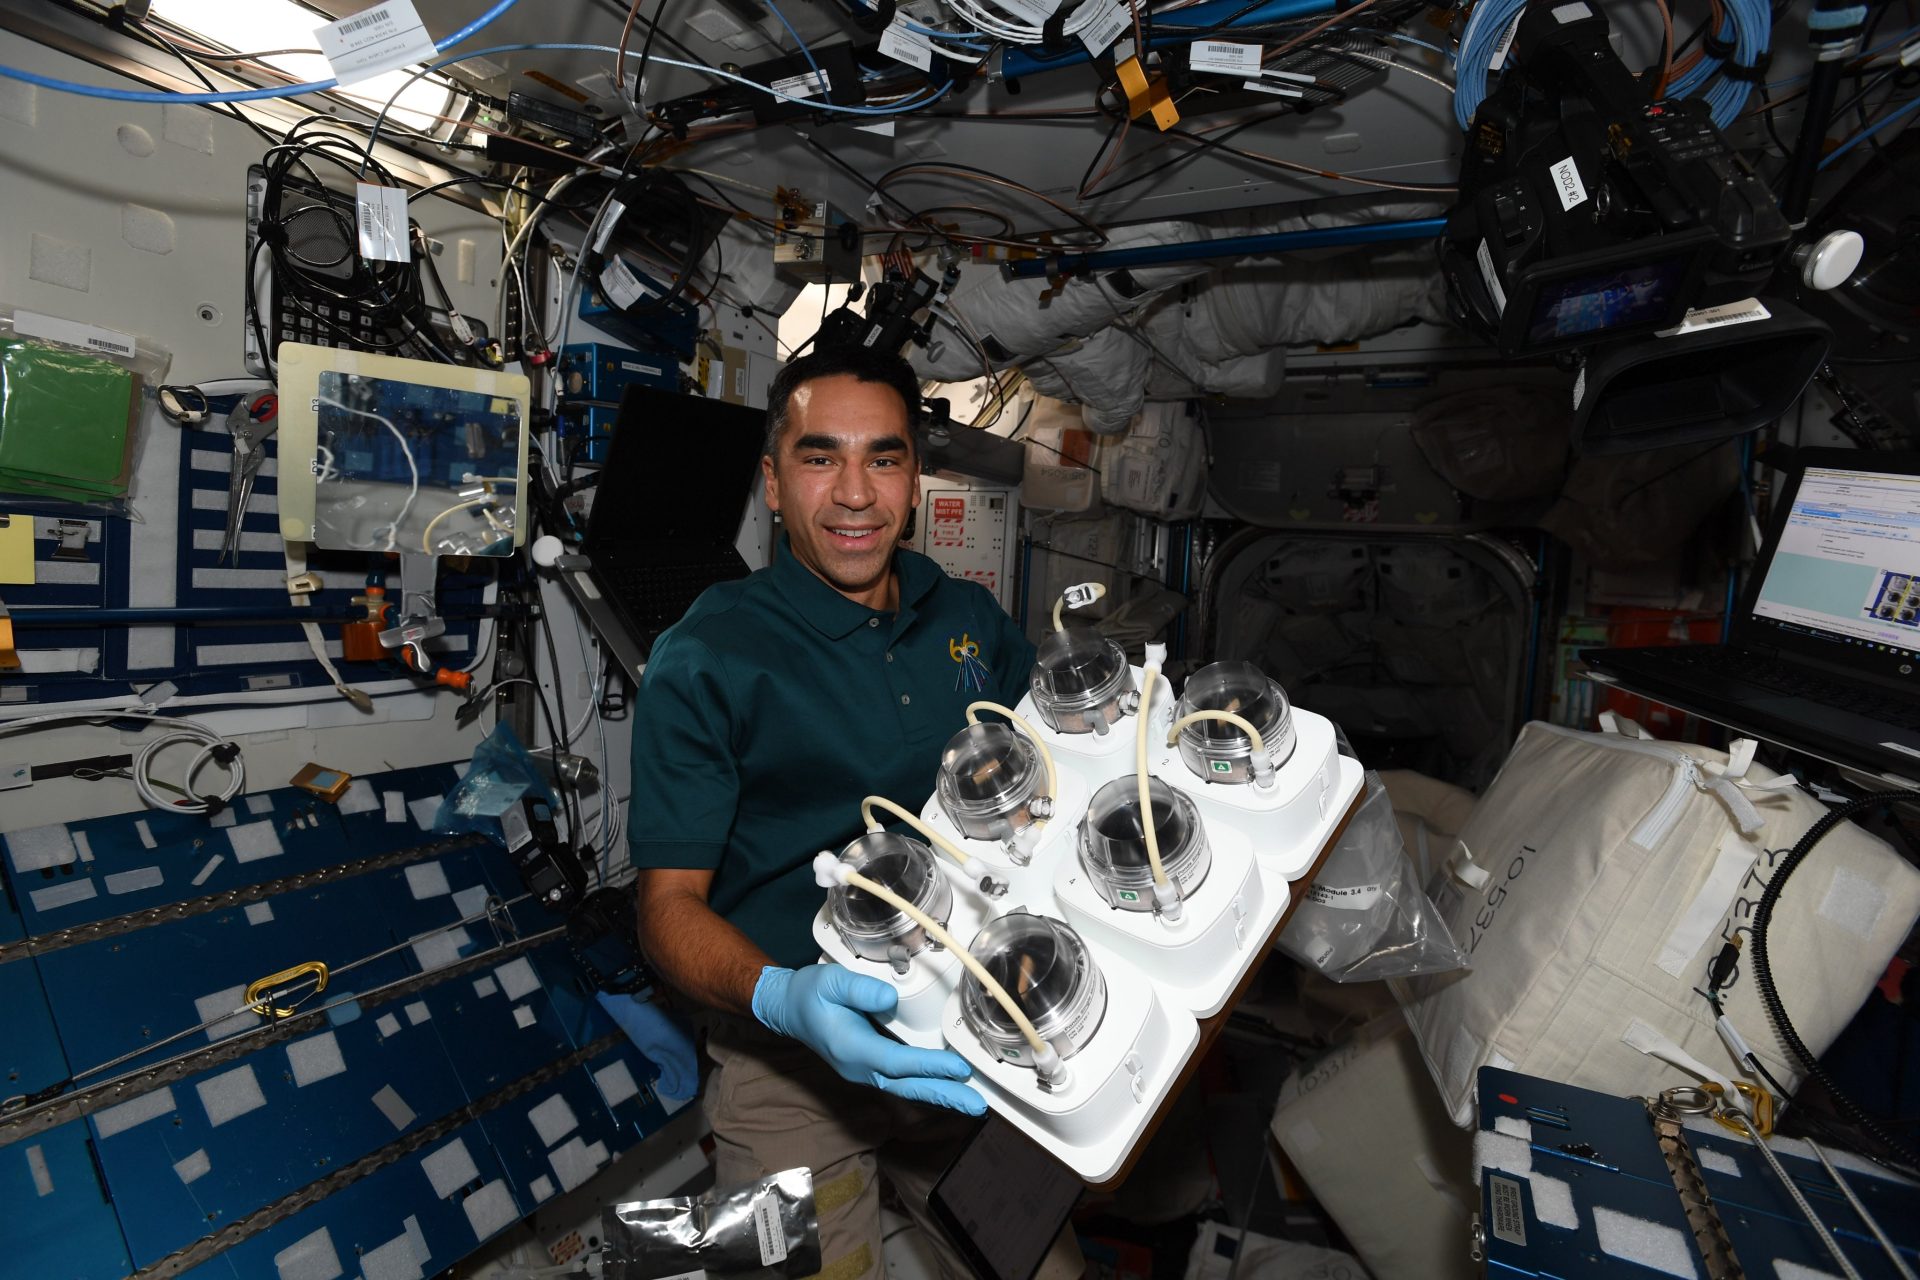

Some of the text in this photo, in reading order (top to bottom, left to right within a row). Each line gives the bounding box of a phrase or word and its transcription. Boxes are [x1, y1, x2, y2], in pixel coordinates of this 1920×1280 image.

[1567, 190, 1580, 203] #2
[312, 398, 320, 412] D3
[1161, 758, 1170, 766] 2
[1318, 885, 1348, 896] Module
[1351, 888, 1361, 896] 3.4
[1466, 846, 1536, 956] 1.0-537
[955, 1016, 964, 1026] 6
[1513, 1220, 1521, 1236] STRAP
